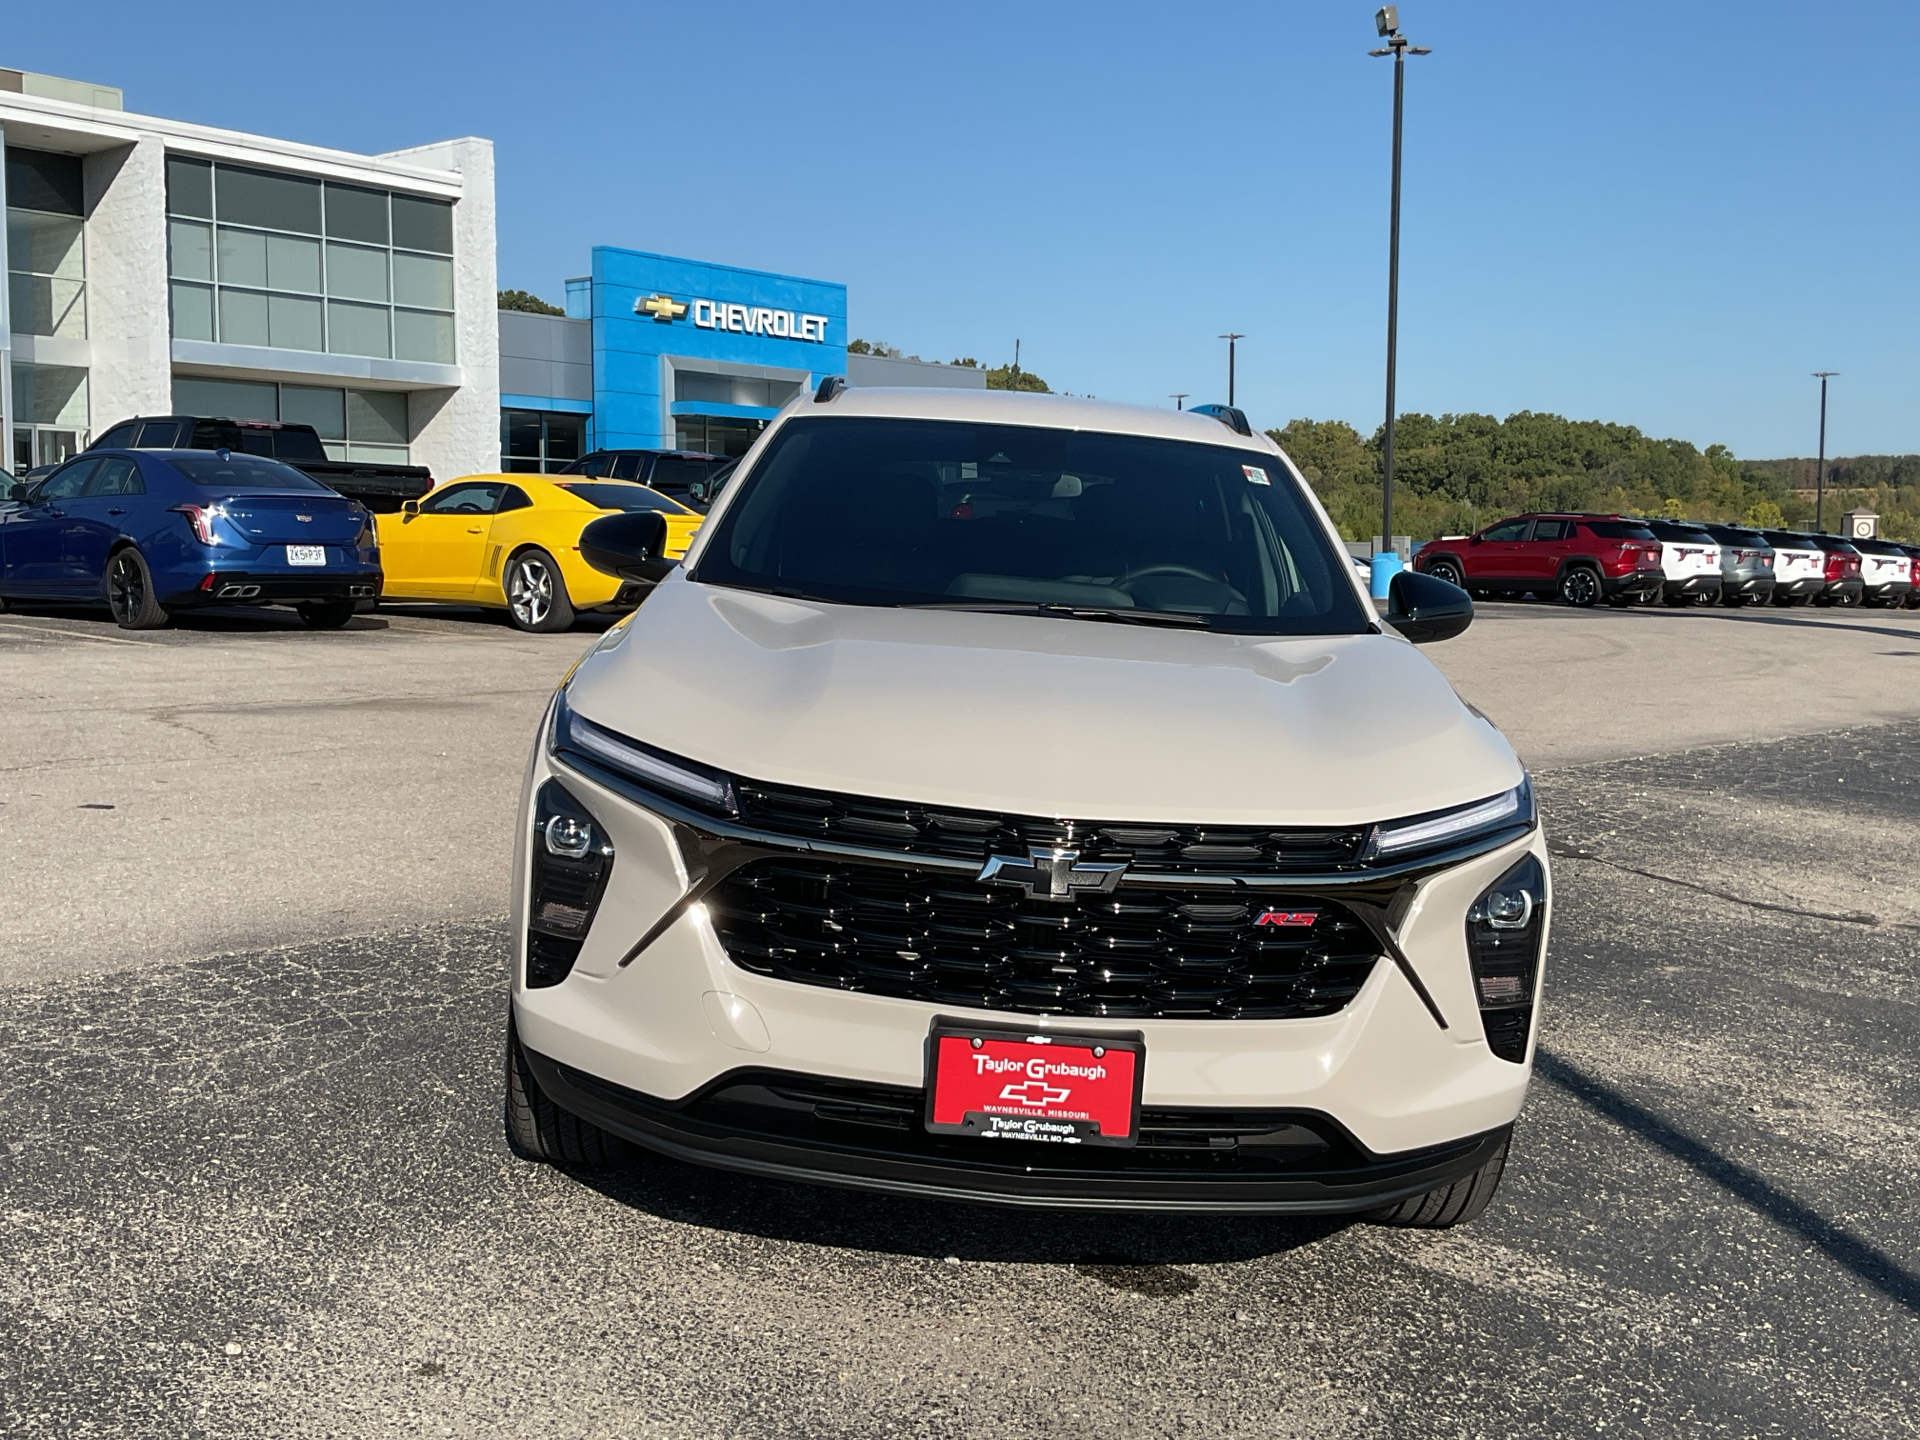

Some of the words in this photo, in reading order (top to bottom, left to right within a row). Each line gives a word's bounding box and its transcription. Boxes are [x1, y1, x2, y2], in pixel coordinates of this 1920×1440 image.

[693, 299, 828, 342] CHEVROLET
[1254, 912, 1318, 926] RS
[972, 1054, 1025, 1075] Taylor
[1026, 1058, 1106, 1080] Grubaugh
[983, 1104, 1045, 1117] WAYNESVILLE,
[1048, 1109, 1090, 1119] MISSOURI
[989, 1116, 1023, 1131] Taylor
[1023, 1119, 1075, 1135] Grubaugh
[1001, 1131, 1050, 1142] WAYNESVILLE,
[1050, 1135, 1062, 1143] MO
